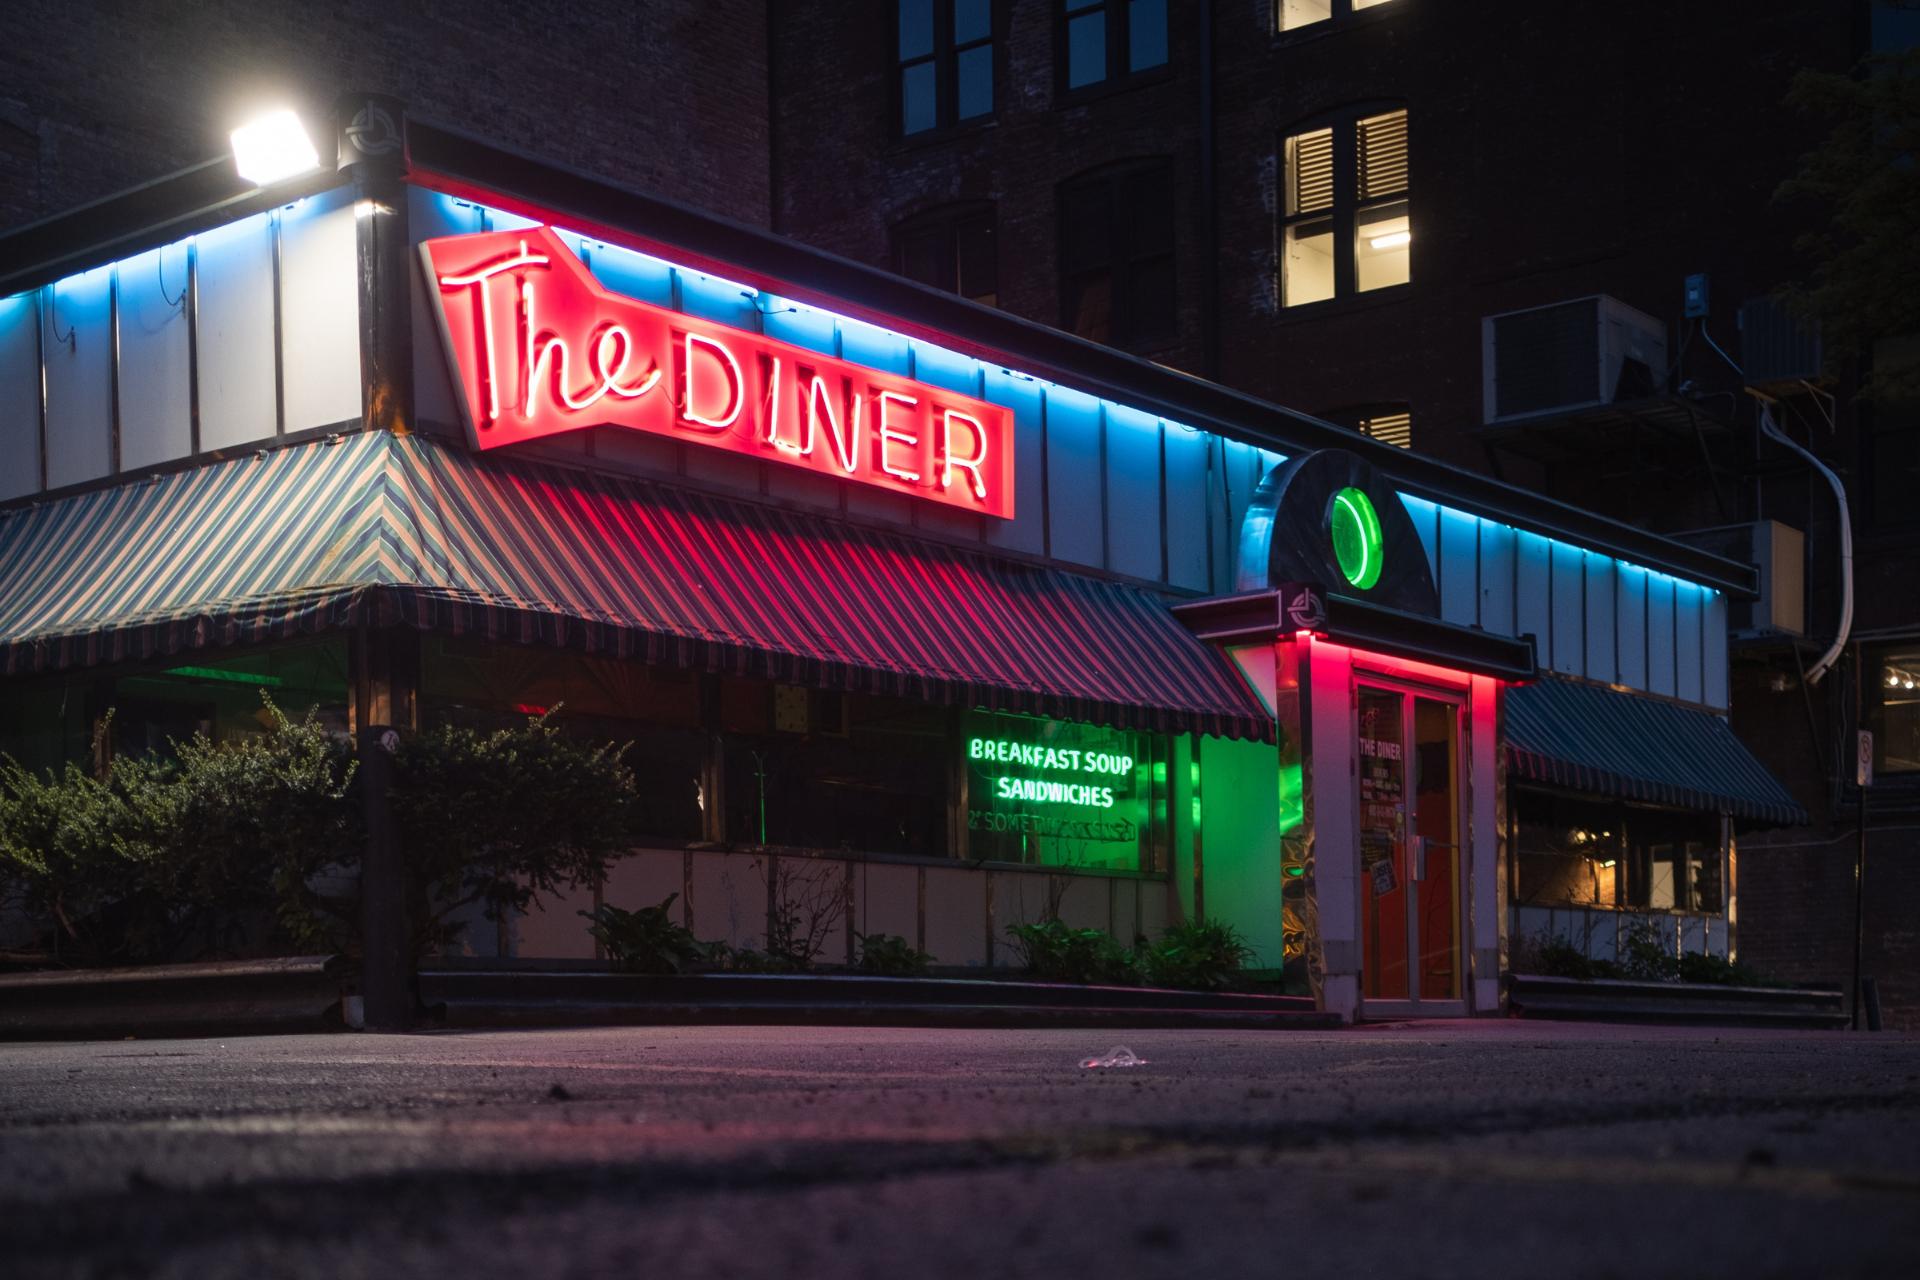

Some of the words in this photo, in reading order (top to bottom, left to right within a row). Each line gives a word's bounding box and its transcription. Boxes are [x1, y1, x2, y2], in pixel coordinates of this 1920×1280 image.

[440, 239, 662, 419] The
[682, 332, 988, 499] DINER
[970, 738, 1081, 771] BREAKFAST
[1084, 750, 1133, 776] SOUP
[1359, 737, 1376, 757] THE
[1377, 741, 1402, 761] DINER
[997, 776, 1114, 808] SANDWICHES
